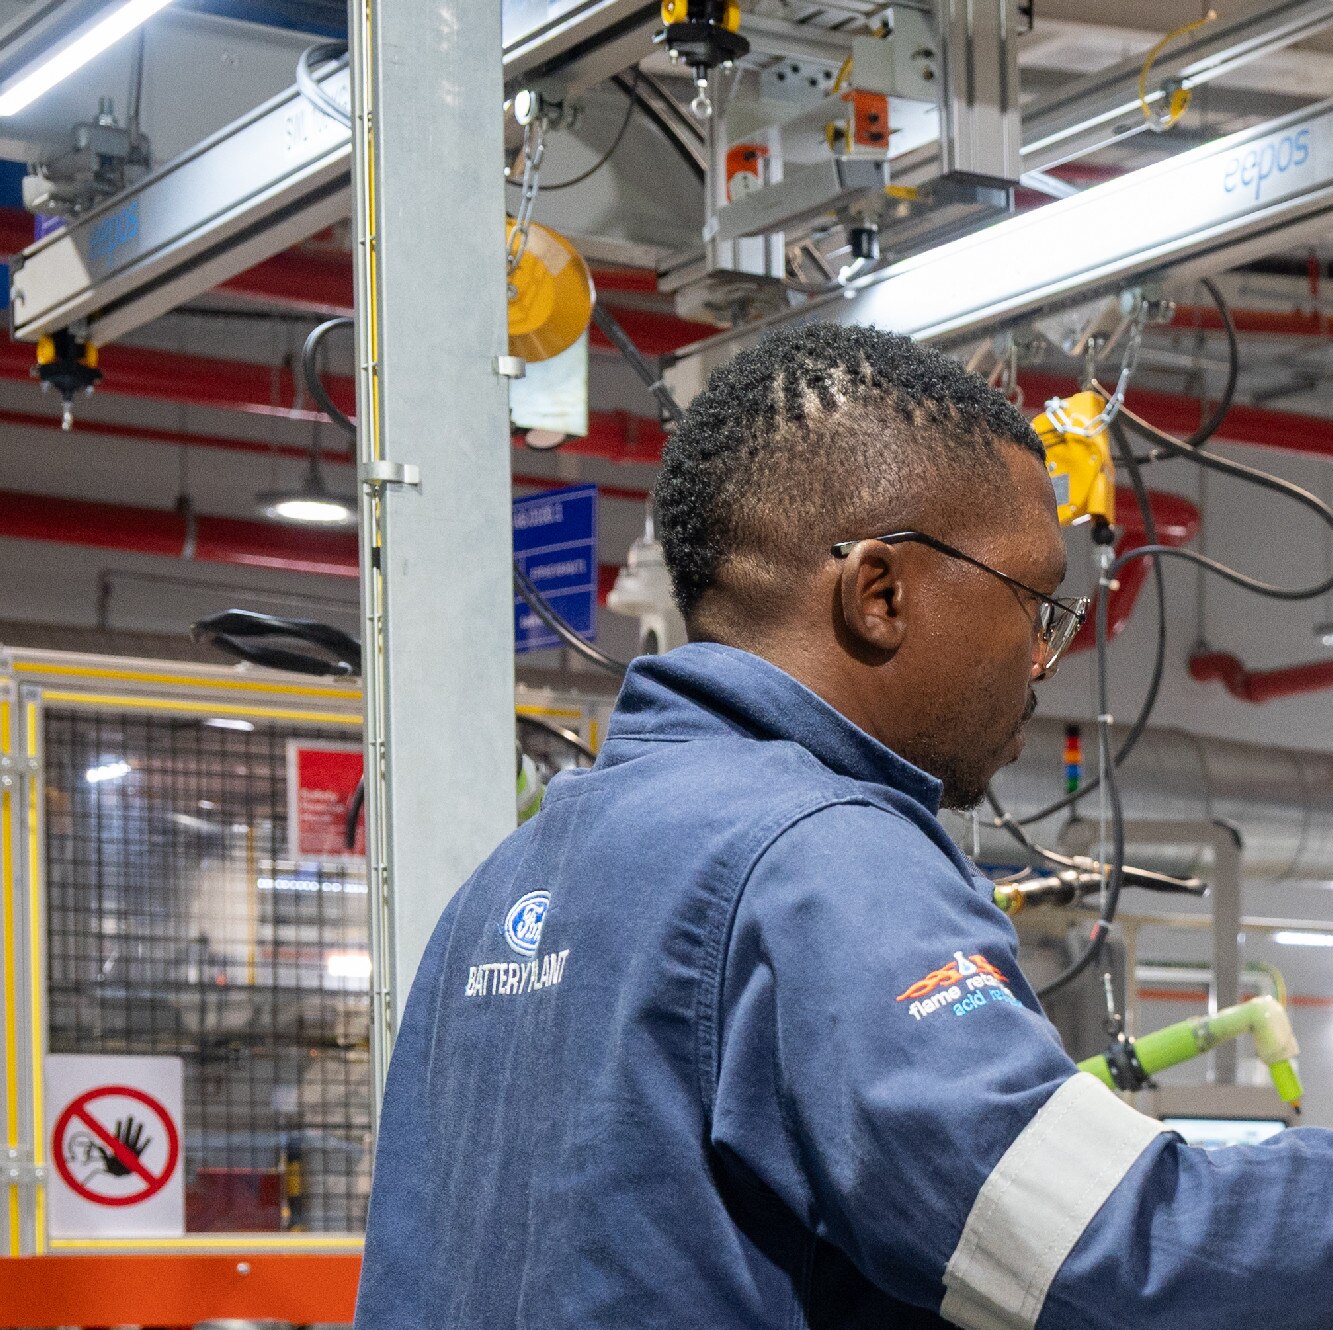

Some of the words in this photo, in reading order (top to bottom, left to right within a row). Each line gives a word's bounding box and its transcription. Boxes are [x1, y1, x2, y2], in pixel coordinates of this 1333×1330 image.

[1224, 128, 1310, 201] eepos
[465, 961, 533, 997] BATTERY
[909, 985, 961, 1020] flame
[953, 989, 987, 1016] acid
